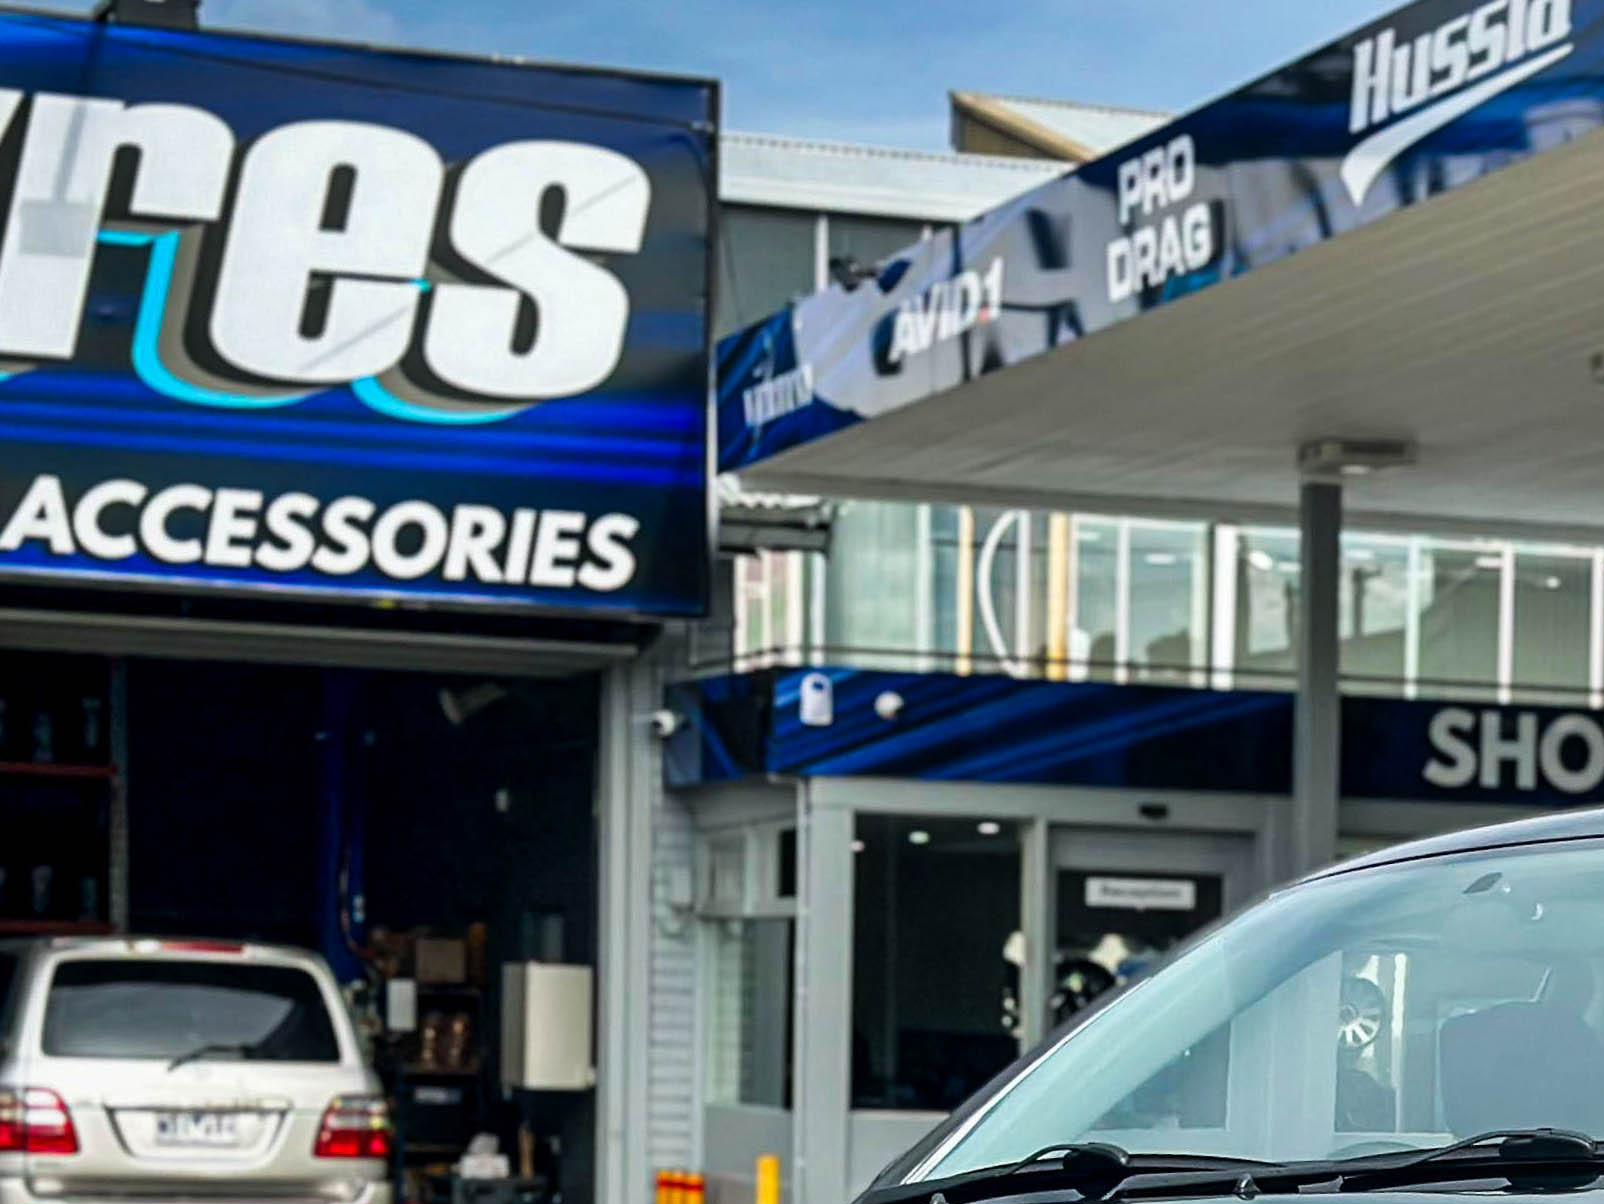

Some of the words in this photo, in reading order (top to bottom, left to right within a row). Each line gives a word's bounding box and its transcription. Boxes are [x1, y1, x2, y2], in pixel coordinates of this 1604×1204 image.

[1117, 134, 1195, 223] PRO
[0, 90, 651, 399] res
[1106, 203, 1211, 302] DRAG
[0, 474, 641, 592] ACCESSORIES
